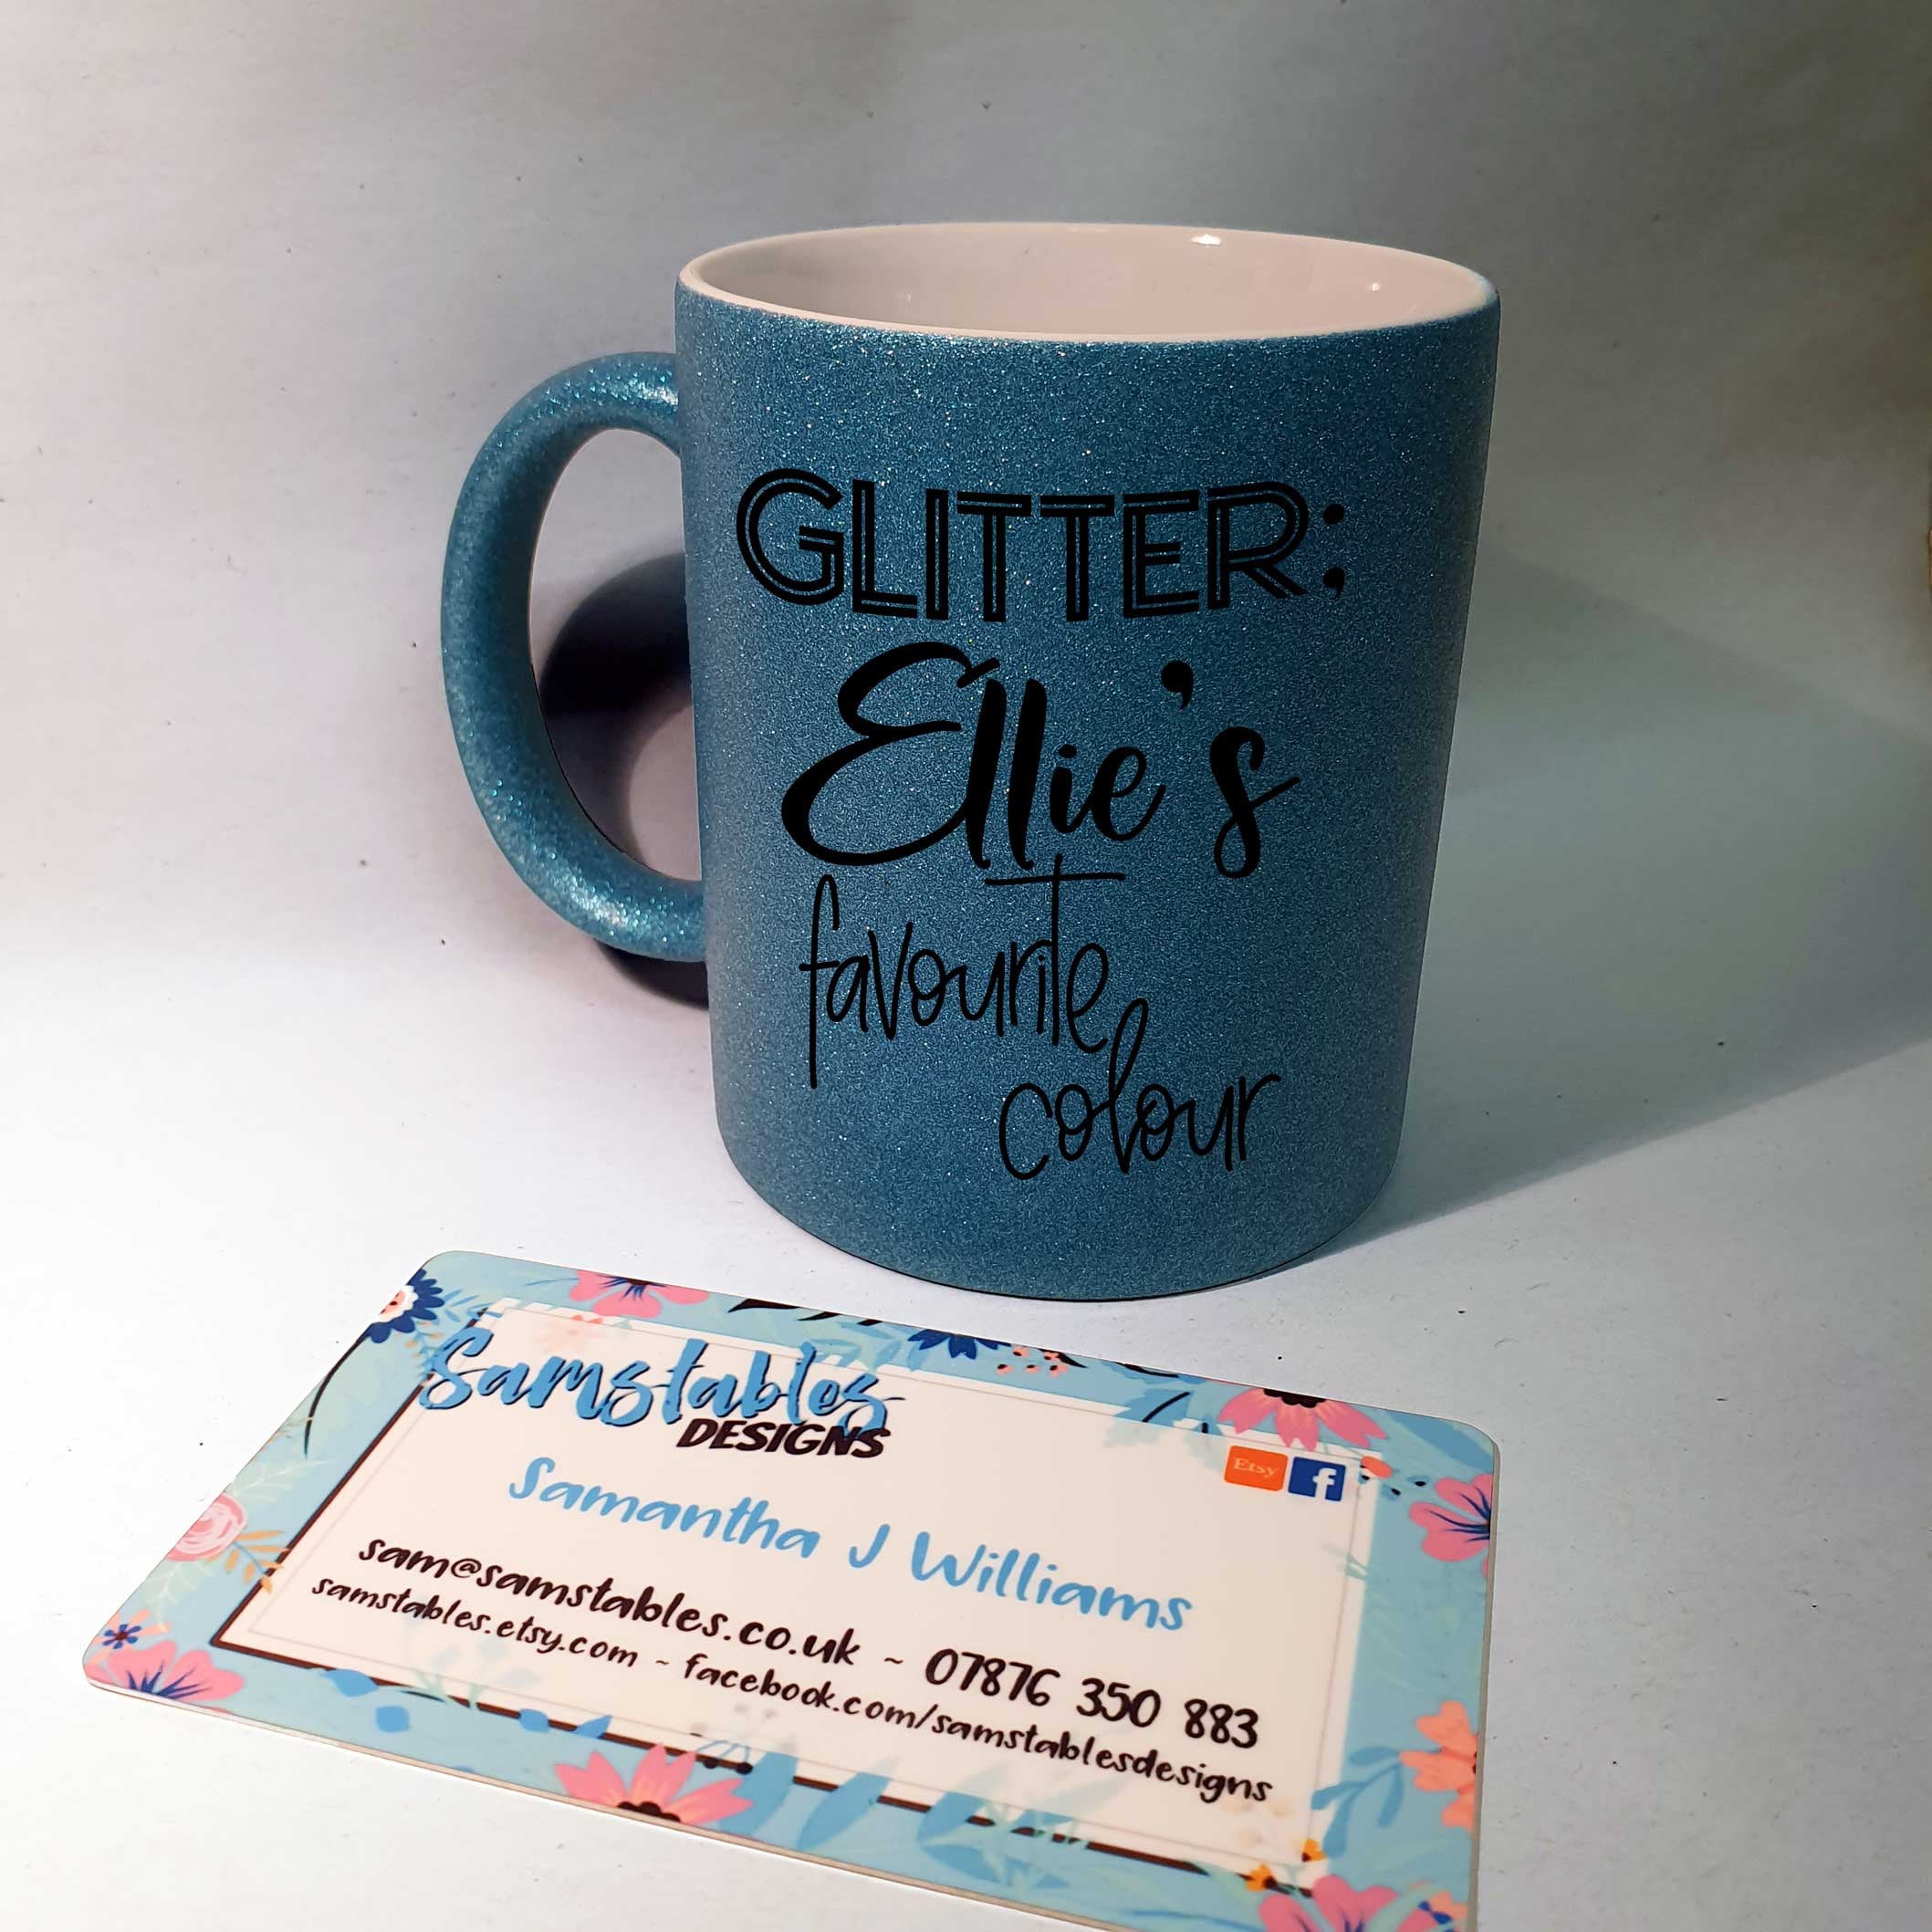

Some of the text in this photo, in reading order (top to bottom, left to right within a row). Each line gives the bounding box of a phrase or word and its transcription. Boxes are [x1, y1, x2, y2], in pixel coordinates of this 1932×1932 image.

[781, 642, 1300, 879] Ellie's
[799, 853, 1125, 1089] favourite
[999, 997, 1280, 1179] colour
[418, 1326, 906, 1441] Samstables
[676, 1417, 892, 1458] DESIGNS
[1233, 1457, 1276, 1478] Etsy
[508, 1457, 1193, 1631] Samantha J Williams
[311, 1578, 638, 1668] samstables.etsy.com
[684, 1653, 1273, 1804] facebook.com/samstablesdesigns
[359, 1538, 861, 1666] sam@samstables.co.uk
[924, 1648, 1060, 1707] 07876
[1076, 1677, 1162, 1728] 350
[1184, 1699, 1259, 1749] 883
